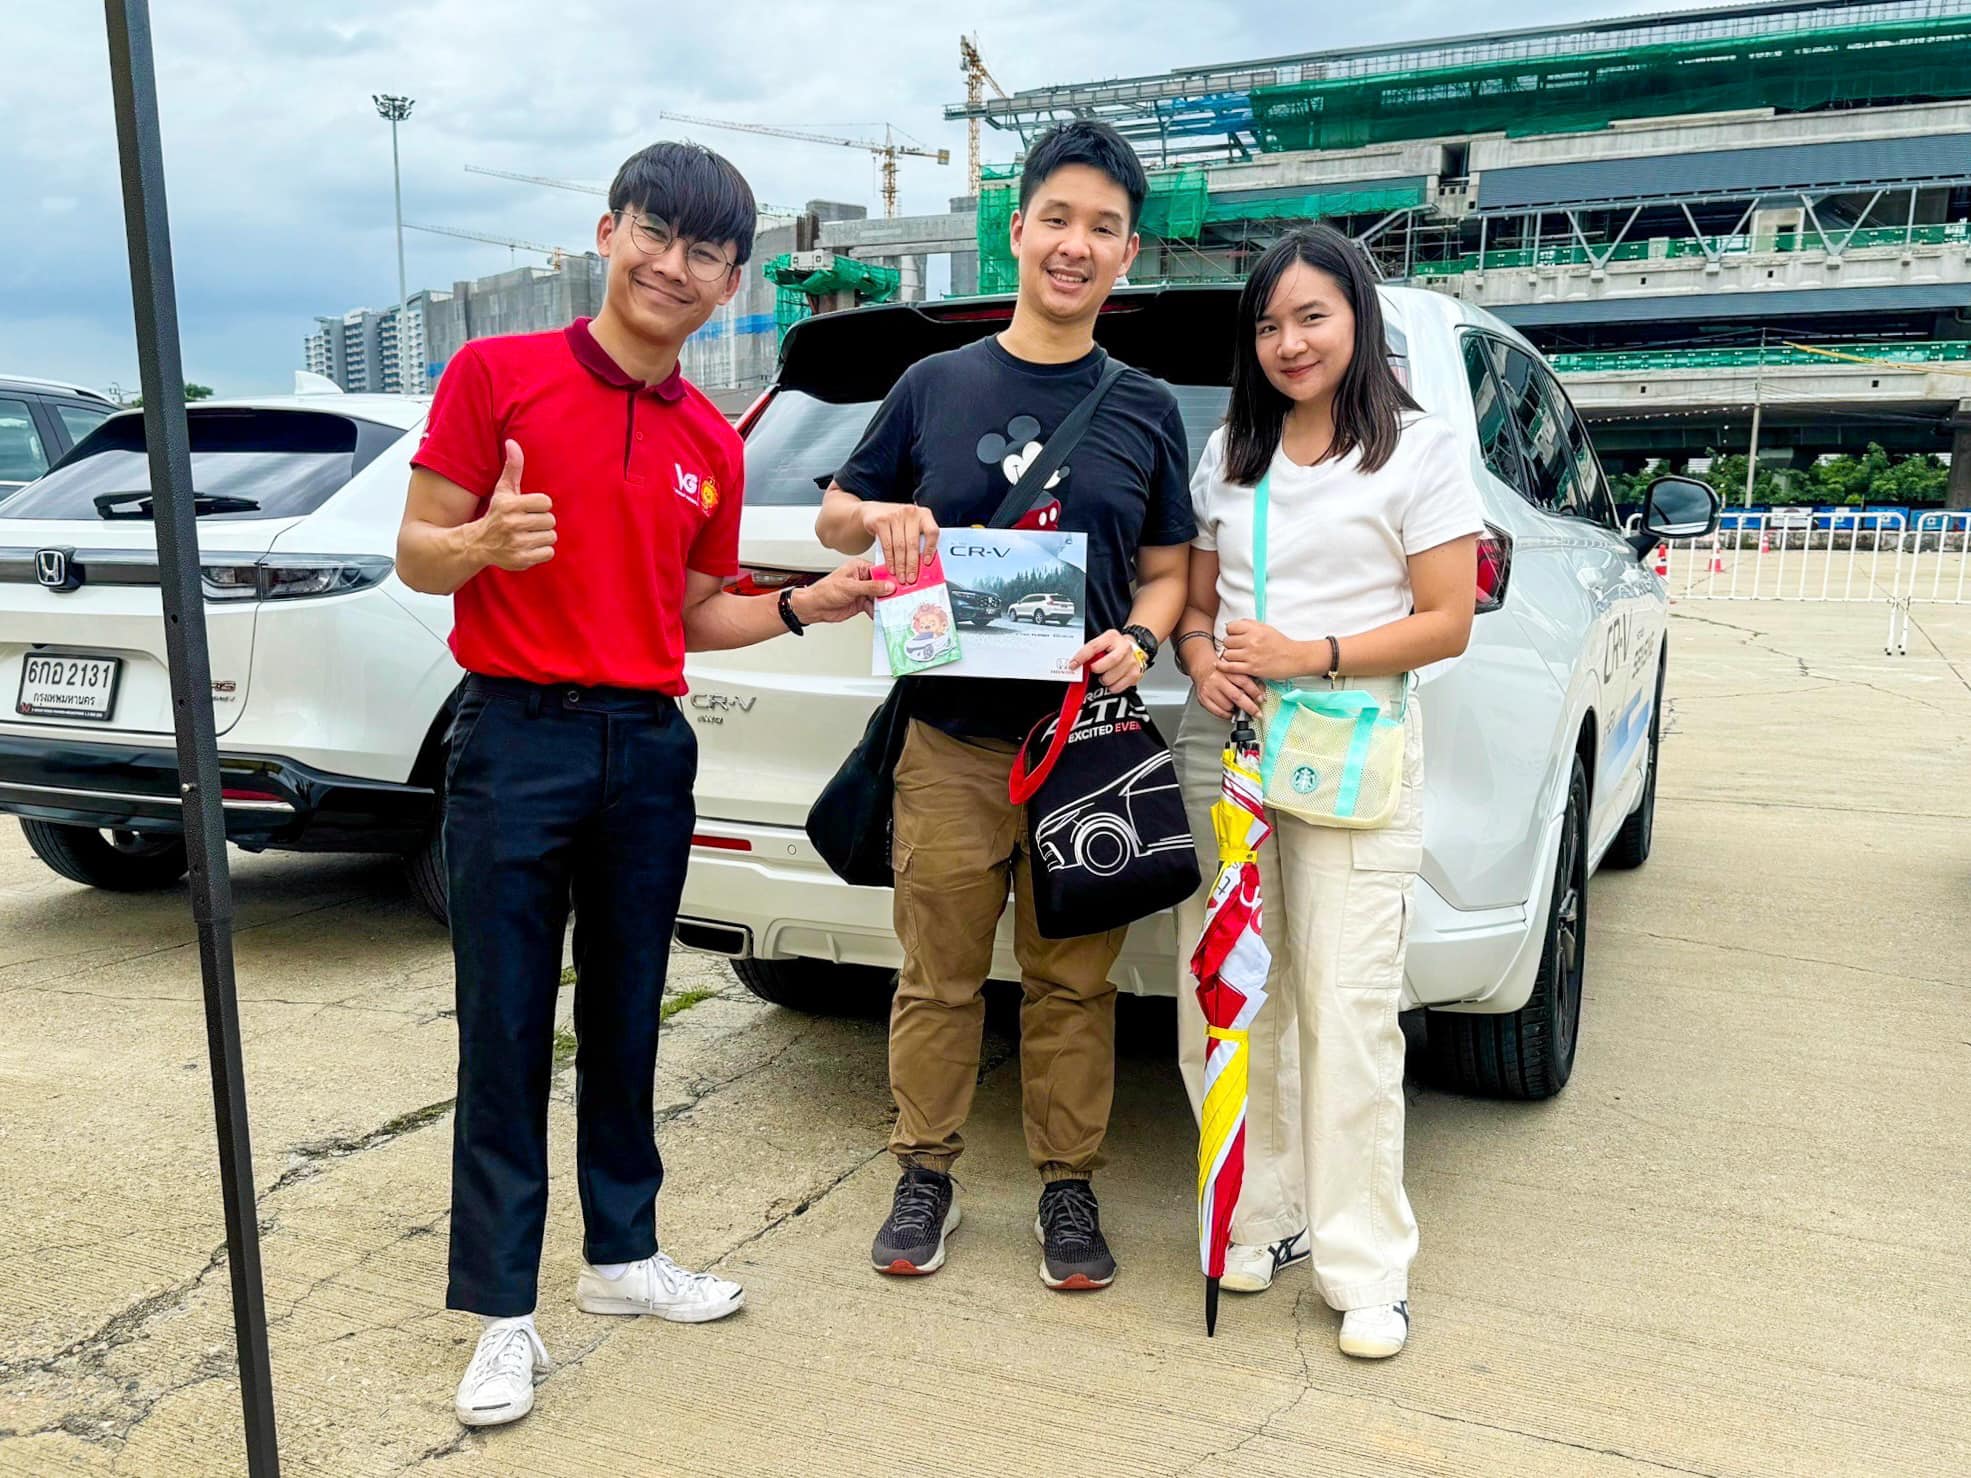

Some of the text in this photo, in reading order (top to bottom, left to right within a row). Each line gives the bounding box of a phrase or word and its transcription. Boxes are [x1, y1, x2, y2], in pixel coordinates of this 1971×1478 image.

[950, 546, 1011, 558] CR-V
[1603, 608, 1632, 685] CR-V
[66, 662, 110, 688] 2131
[33, 692, 96, 706] กรุงเทพมหานคร
[690, 694, 757, 712] CR-V
[1068, 724, 1114, 744] EXCITED
